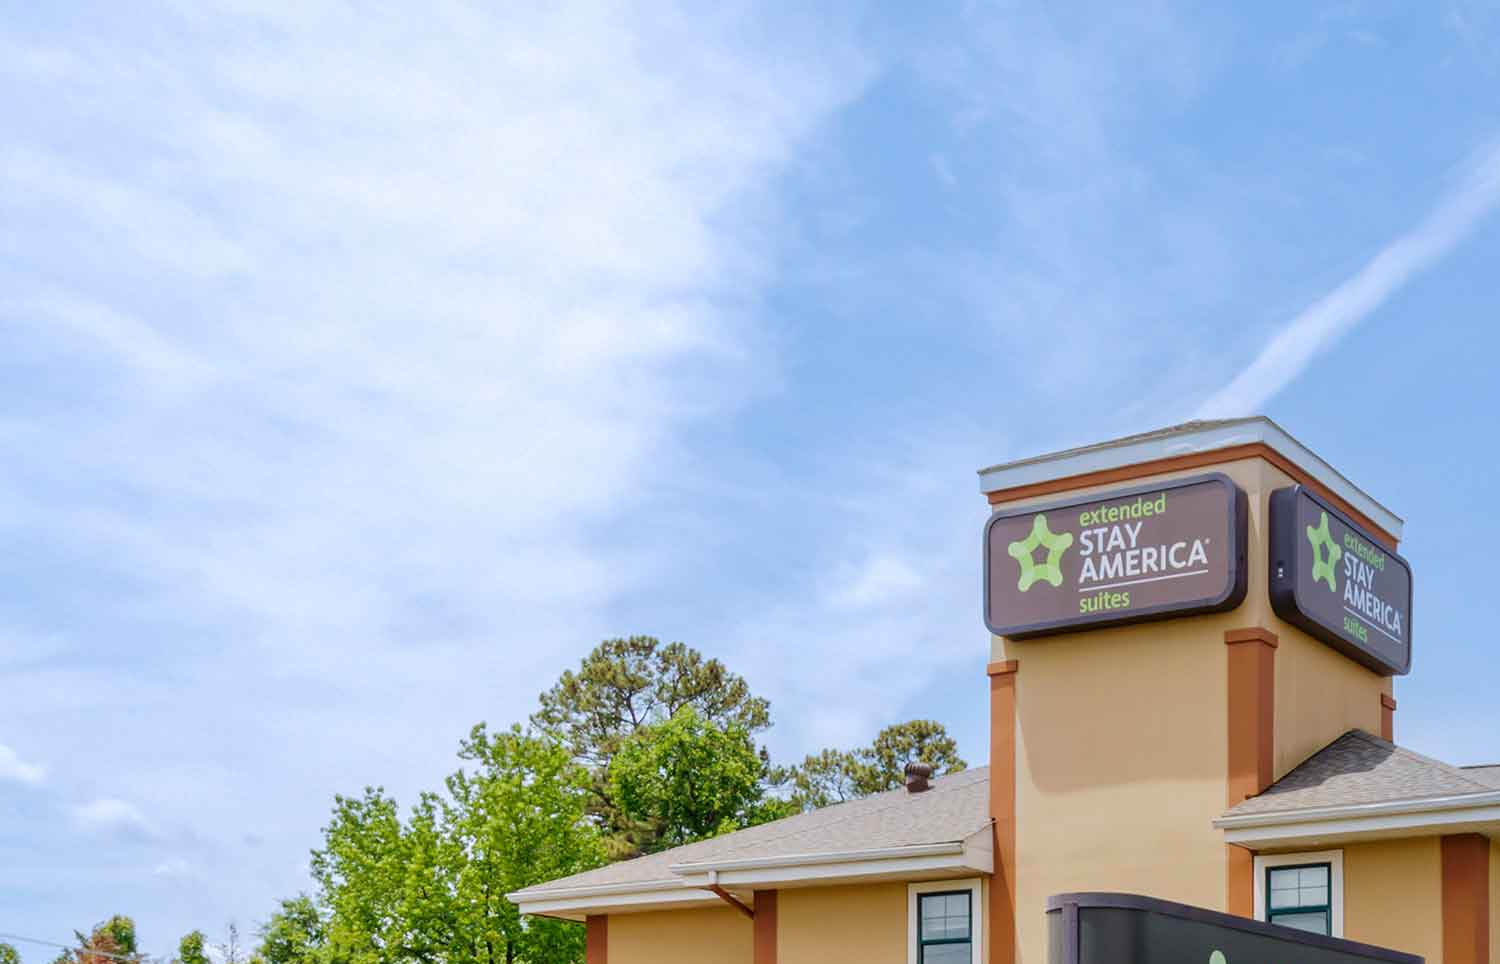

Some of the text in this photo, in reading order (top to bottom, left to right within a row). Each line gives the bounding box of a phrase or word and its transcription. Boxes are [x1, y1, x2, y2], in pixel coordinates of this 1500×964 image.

[1079, 493, 1167, 527] extended
[1079, 521, 1143, 556] STAY
[1344, 533, 1385, 571] extended
[1079, 538, 1208, 583] AMERICA
[1343, 551, 1375, 590] STAY
[1079, 590, 1130, 613] suites
[1343, 578, 1402, 634] AMERICA
